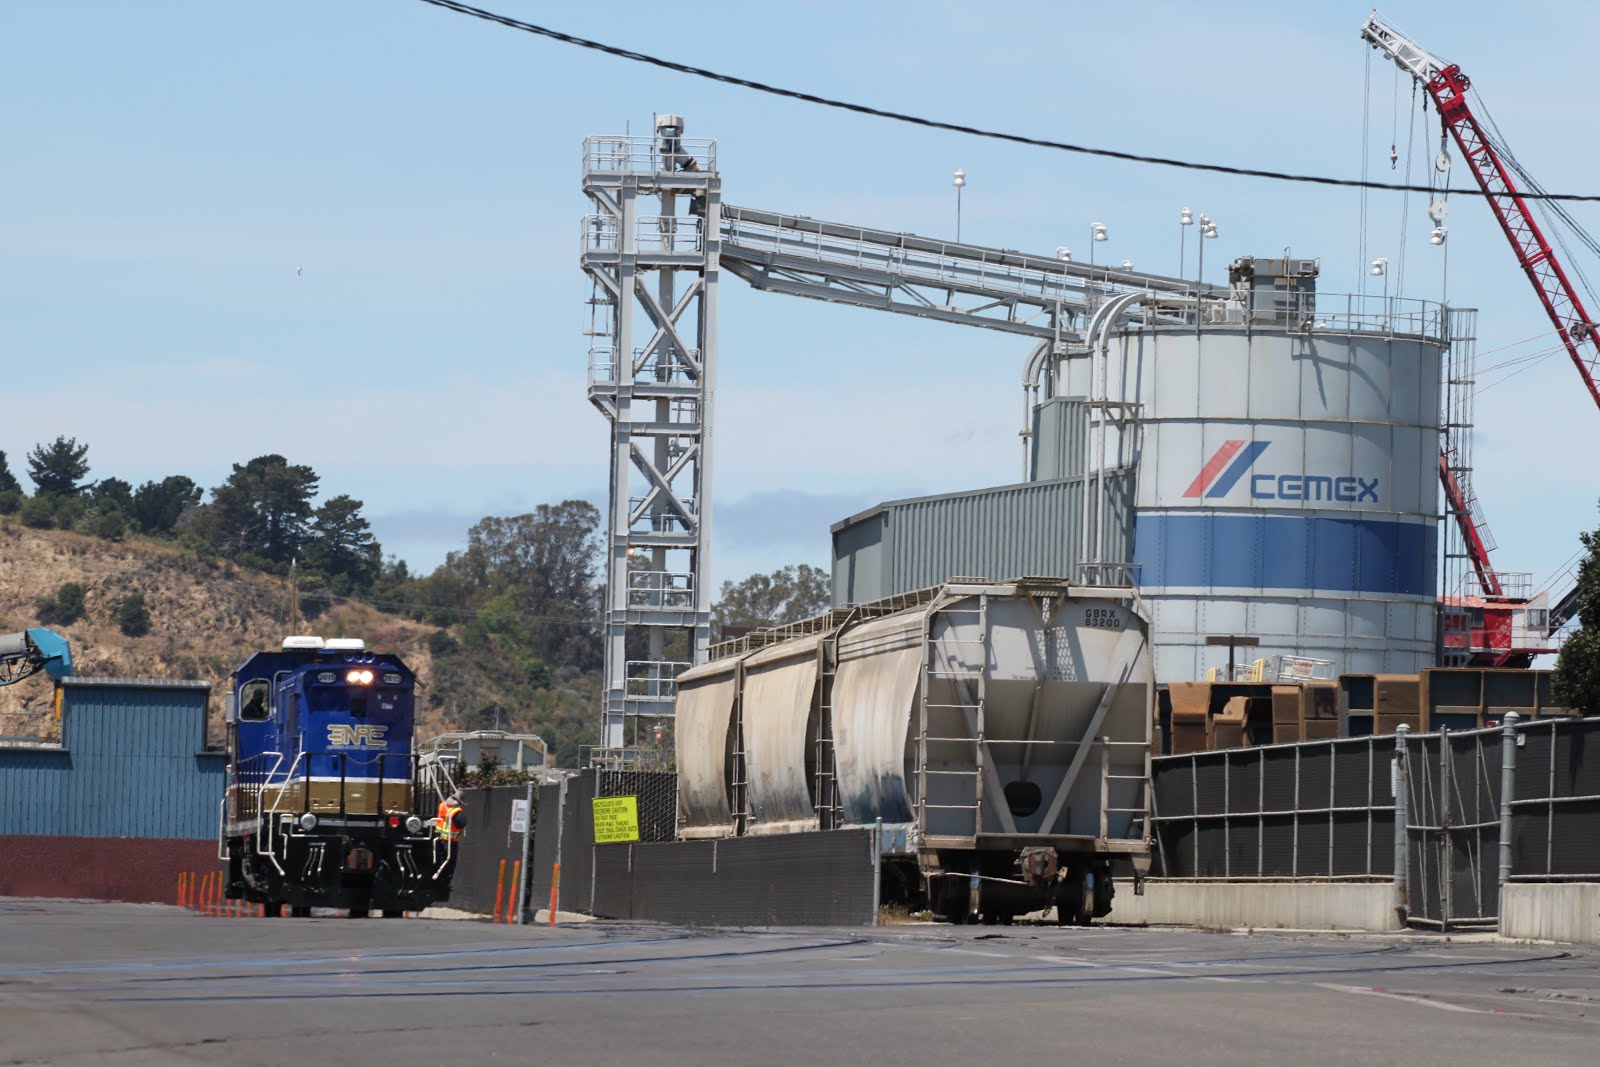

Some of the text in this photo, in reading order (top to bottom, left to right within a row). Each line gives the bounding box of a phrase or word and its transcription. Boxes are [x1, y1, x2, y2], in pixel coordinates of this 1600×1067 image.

[1251, 474, 1378, 503] CEMEX
[1085, 609, 1116, 618] GBRX
[1085, 618, 1120, 627] 83200
[319, 673, 336, 681] 2015
